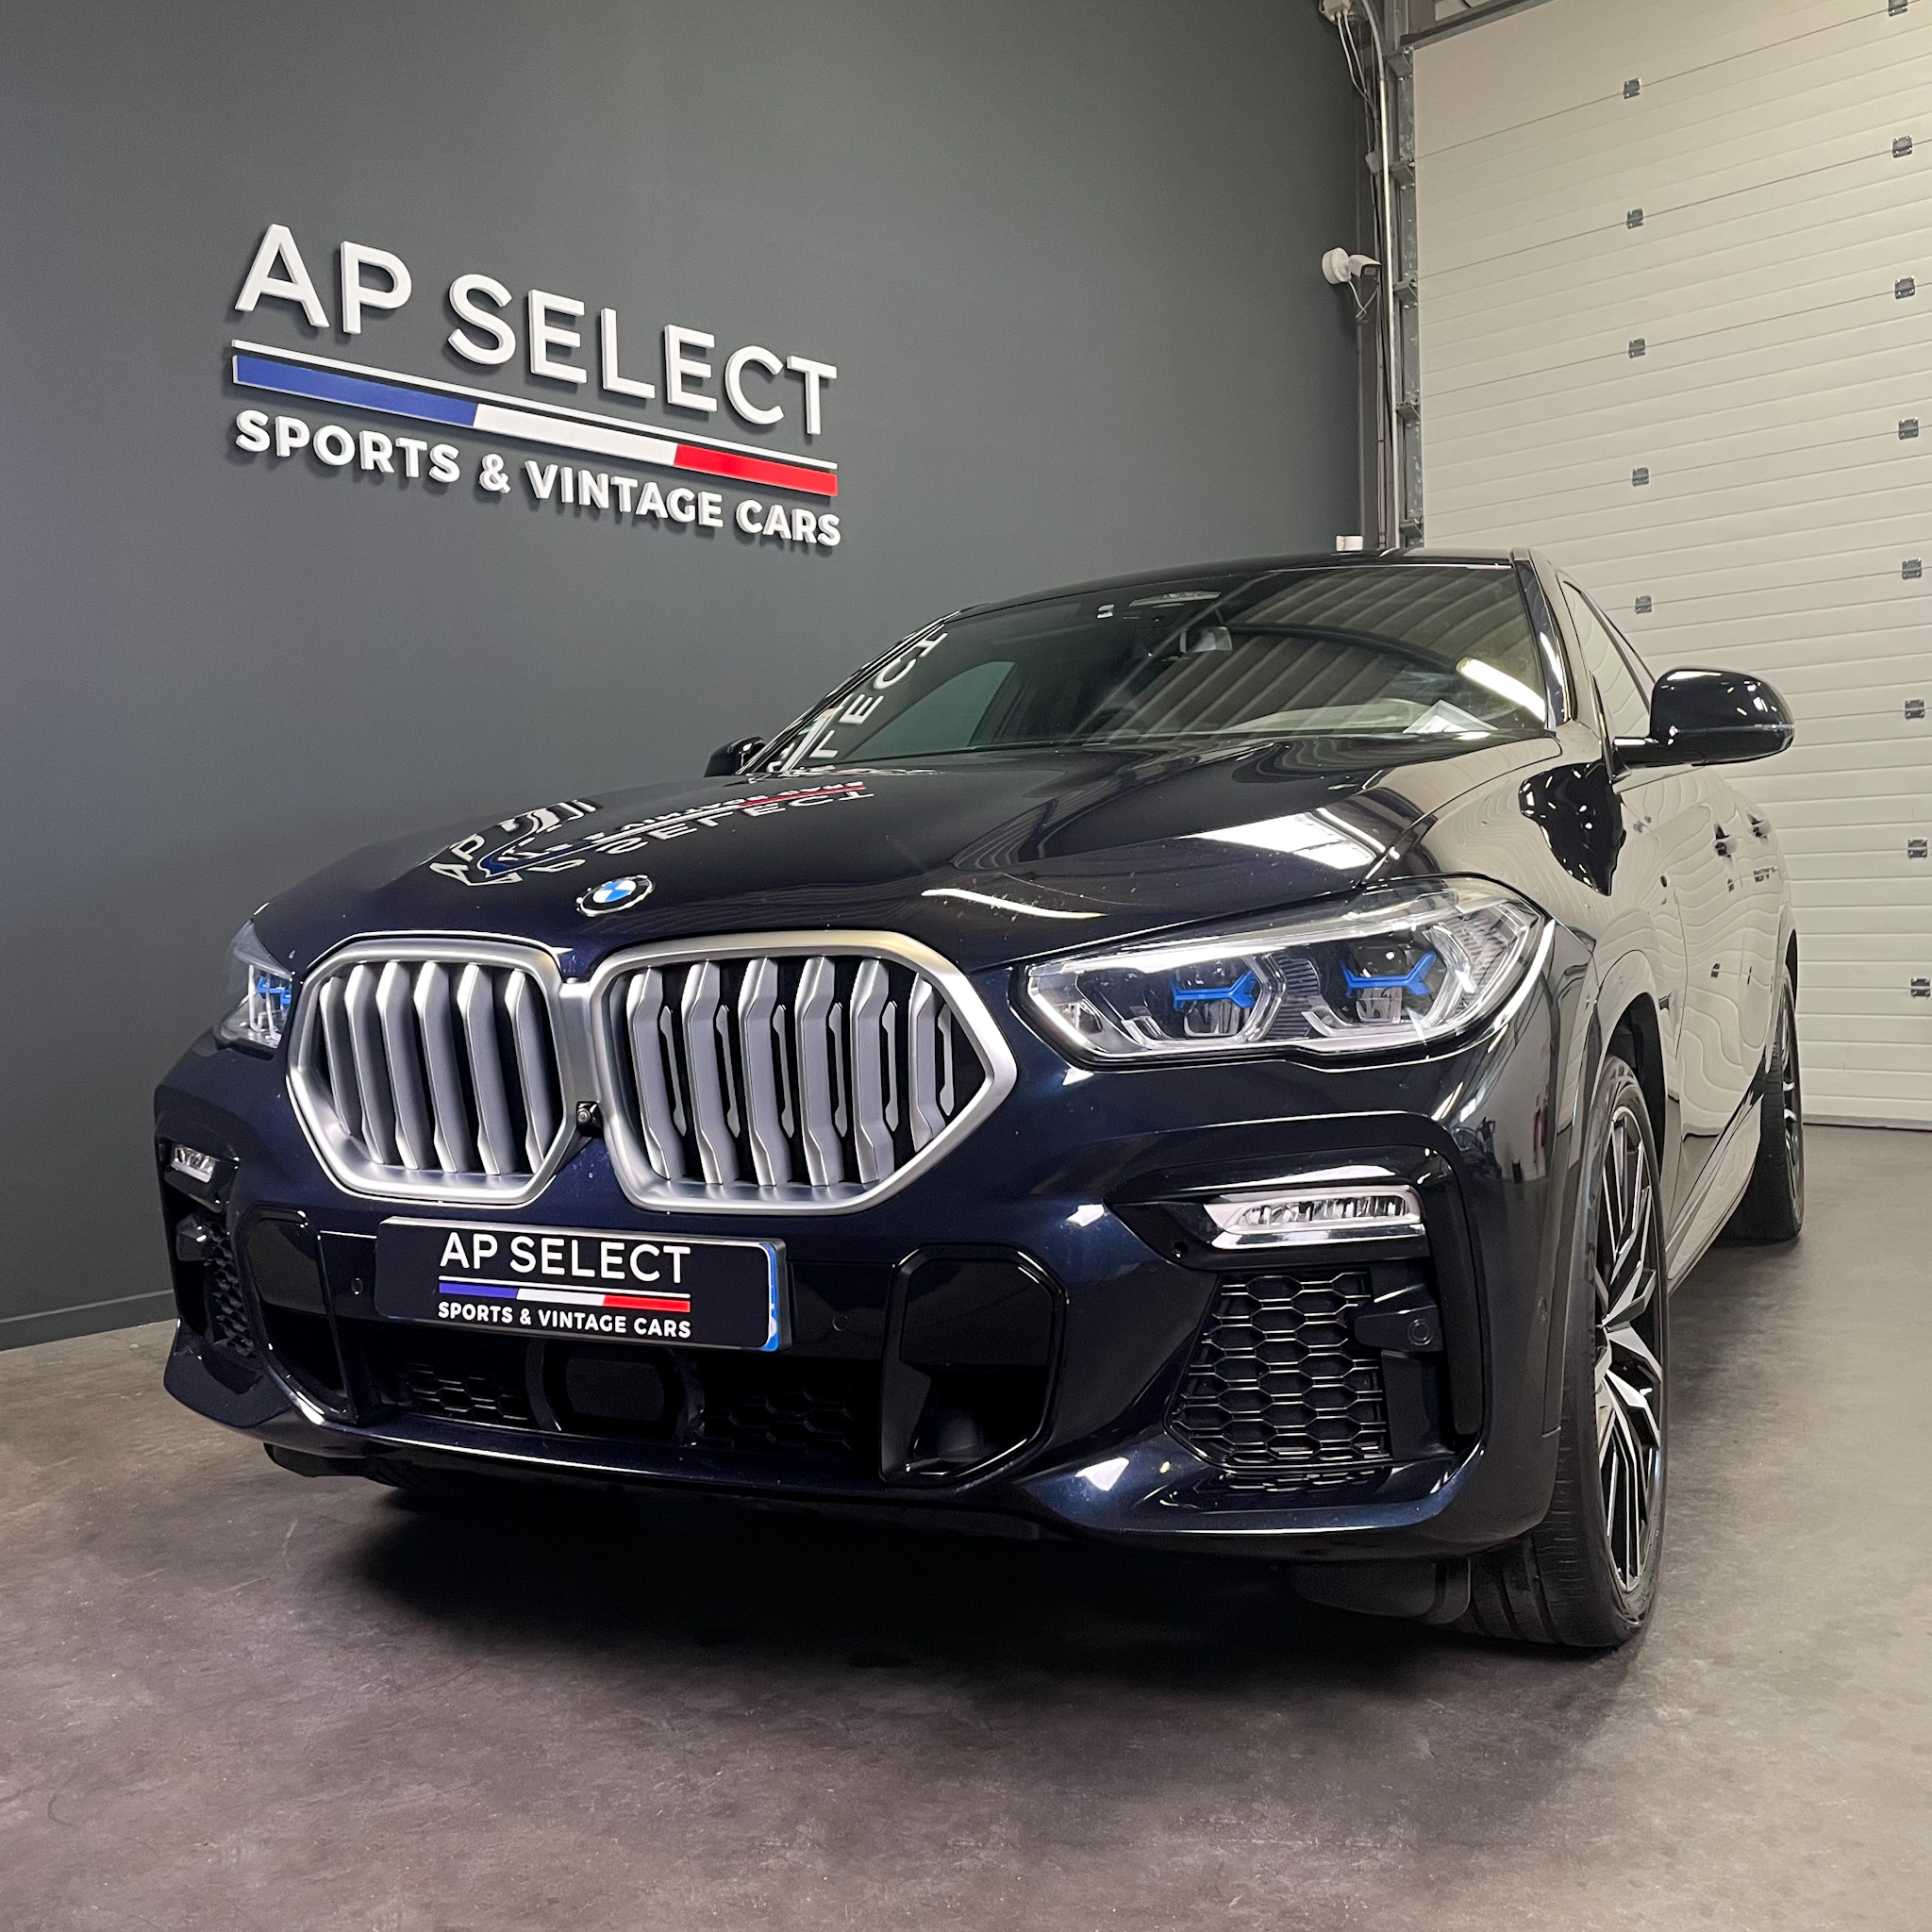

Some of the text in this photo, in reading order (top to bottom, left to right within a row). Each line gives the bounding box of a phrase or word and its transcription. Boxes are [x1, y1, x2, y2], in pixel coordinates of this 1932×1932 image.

[234, 223, 838, 435] AP SELECT
[235, 409, 841, 546] SPORTS & VINTAGE CARS
[440, 1231, 691, 1284] AP SELECT
[438, 1301, 691, 1339] SPORTS & VINTAGE CARS
